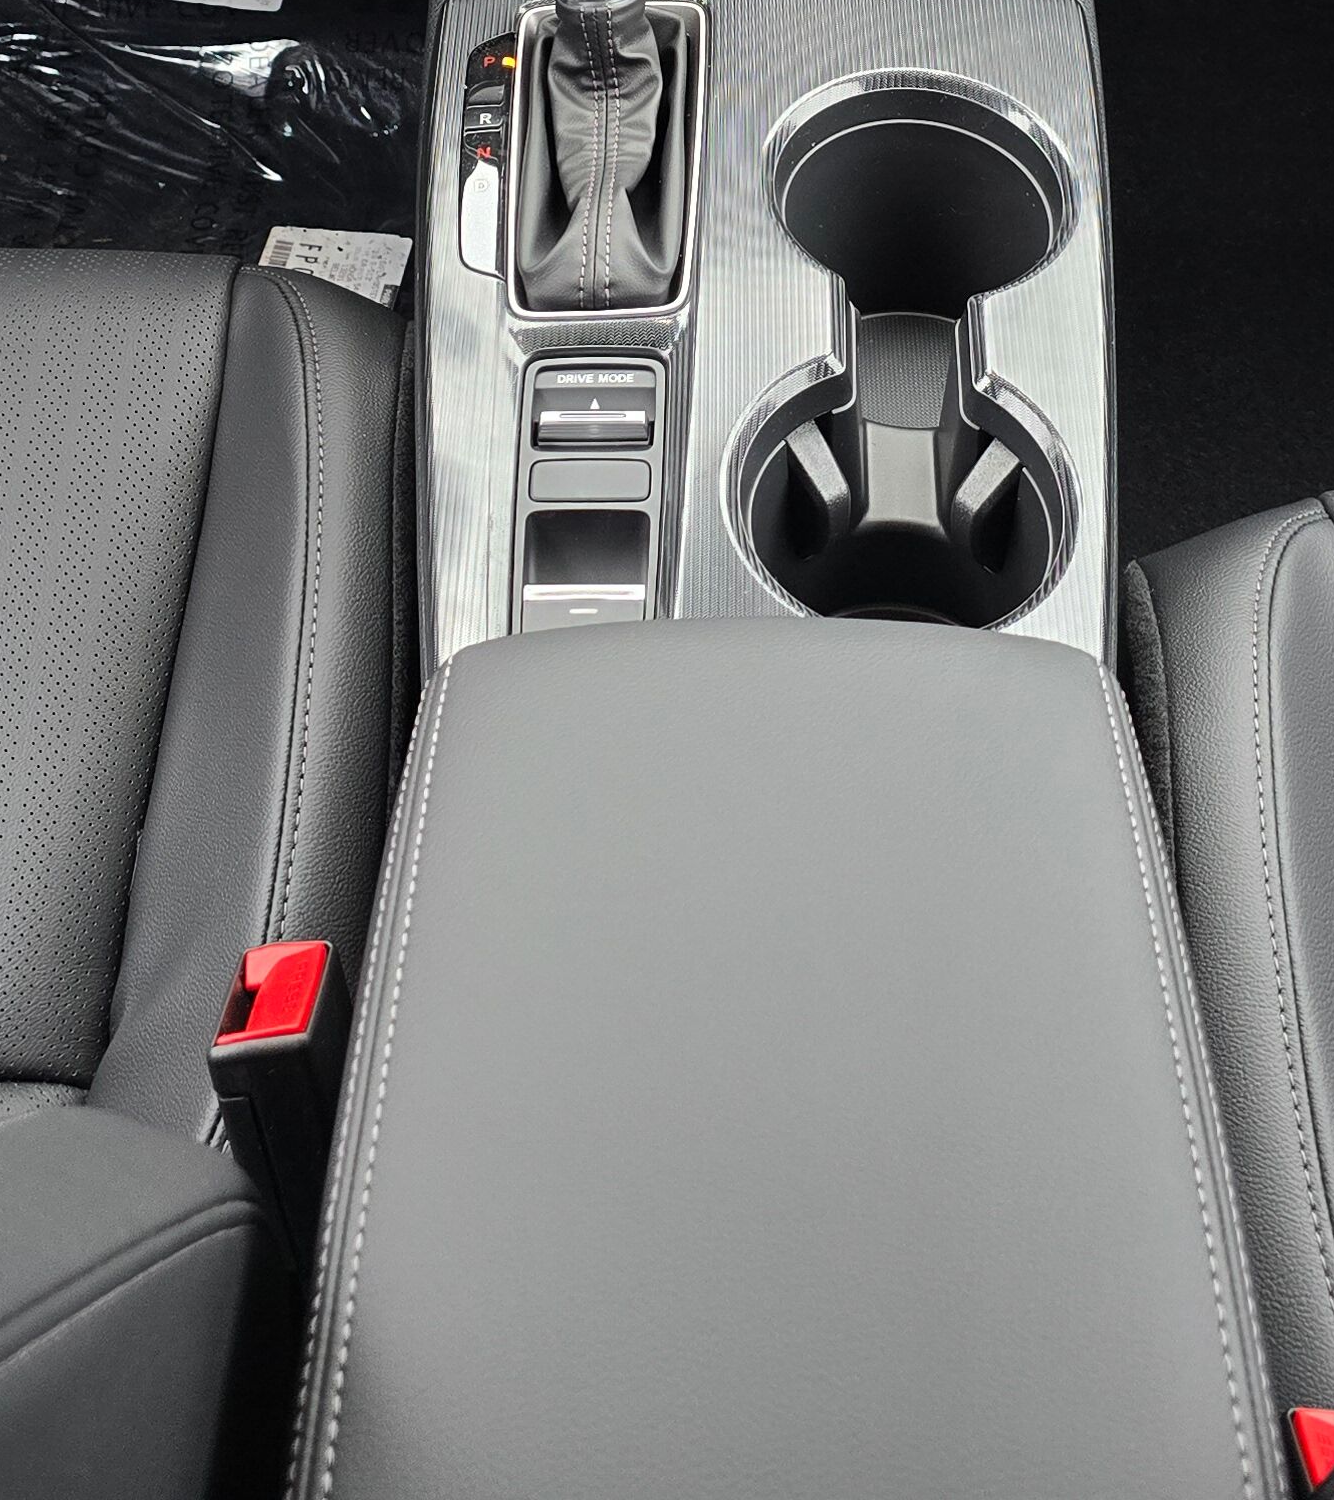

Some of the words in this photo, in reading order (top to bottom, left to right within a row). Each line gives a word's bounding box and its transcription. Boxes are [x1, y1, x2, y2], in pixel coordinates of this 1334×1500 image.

[483, 56, 496, 68] P
[479, 113, 493, 125] R
[477, 146, 491, 158] N
[557, 373, 595, 384] DRIVE
[597, 373, 635, 384] MODE
